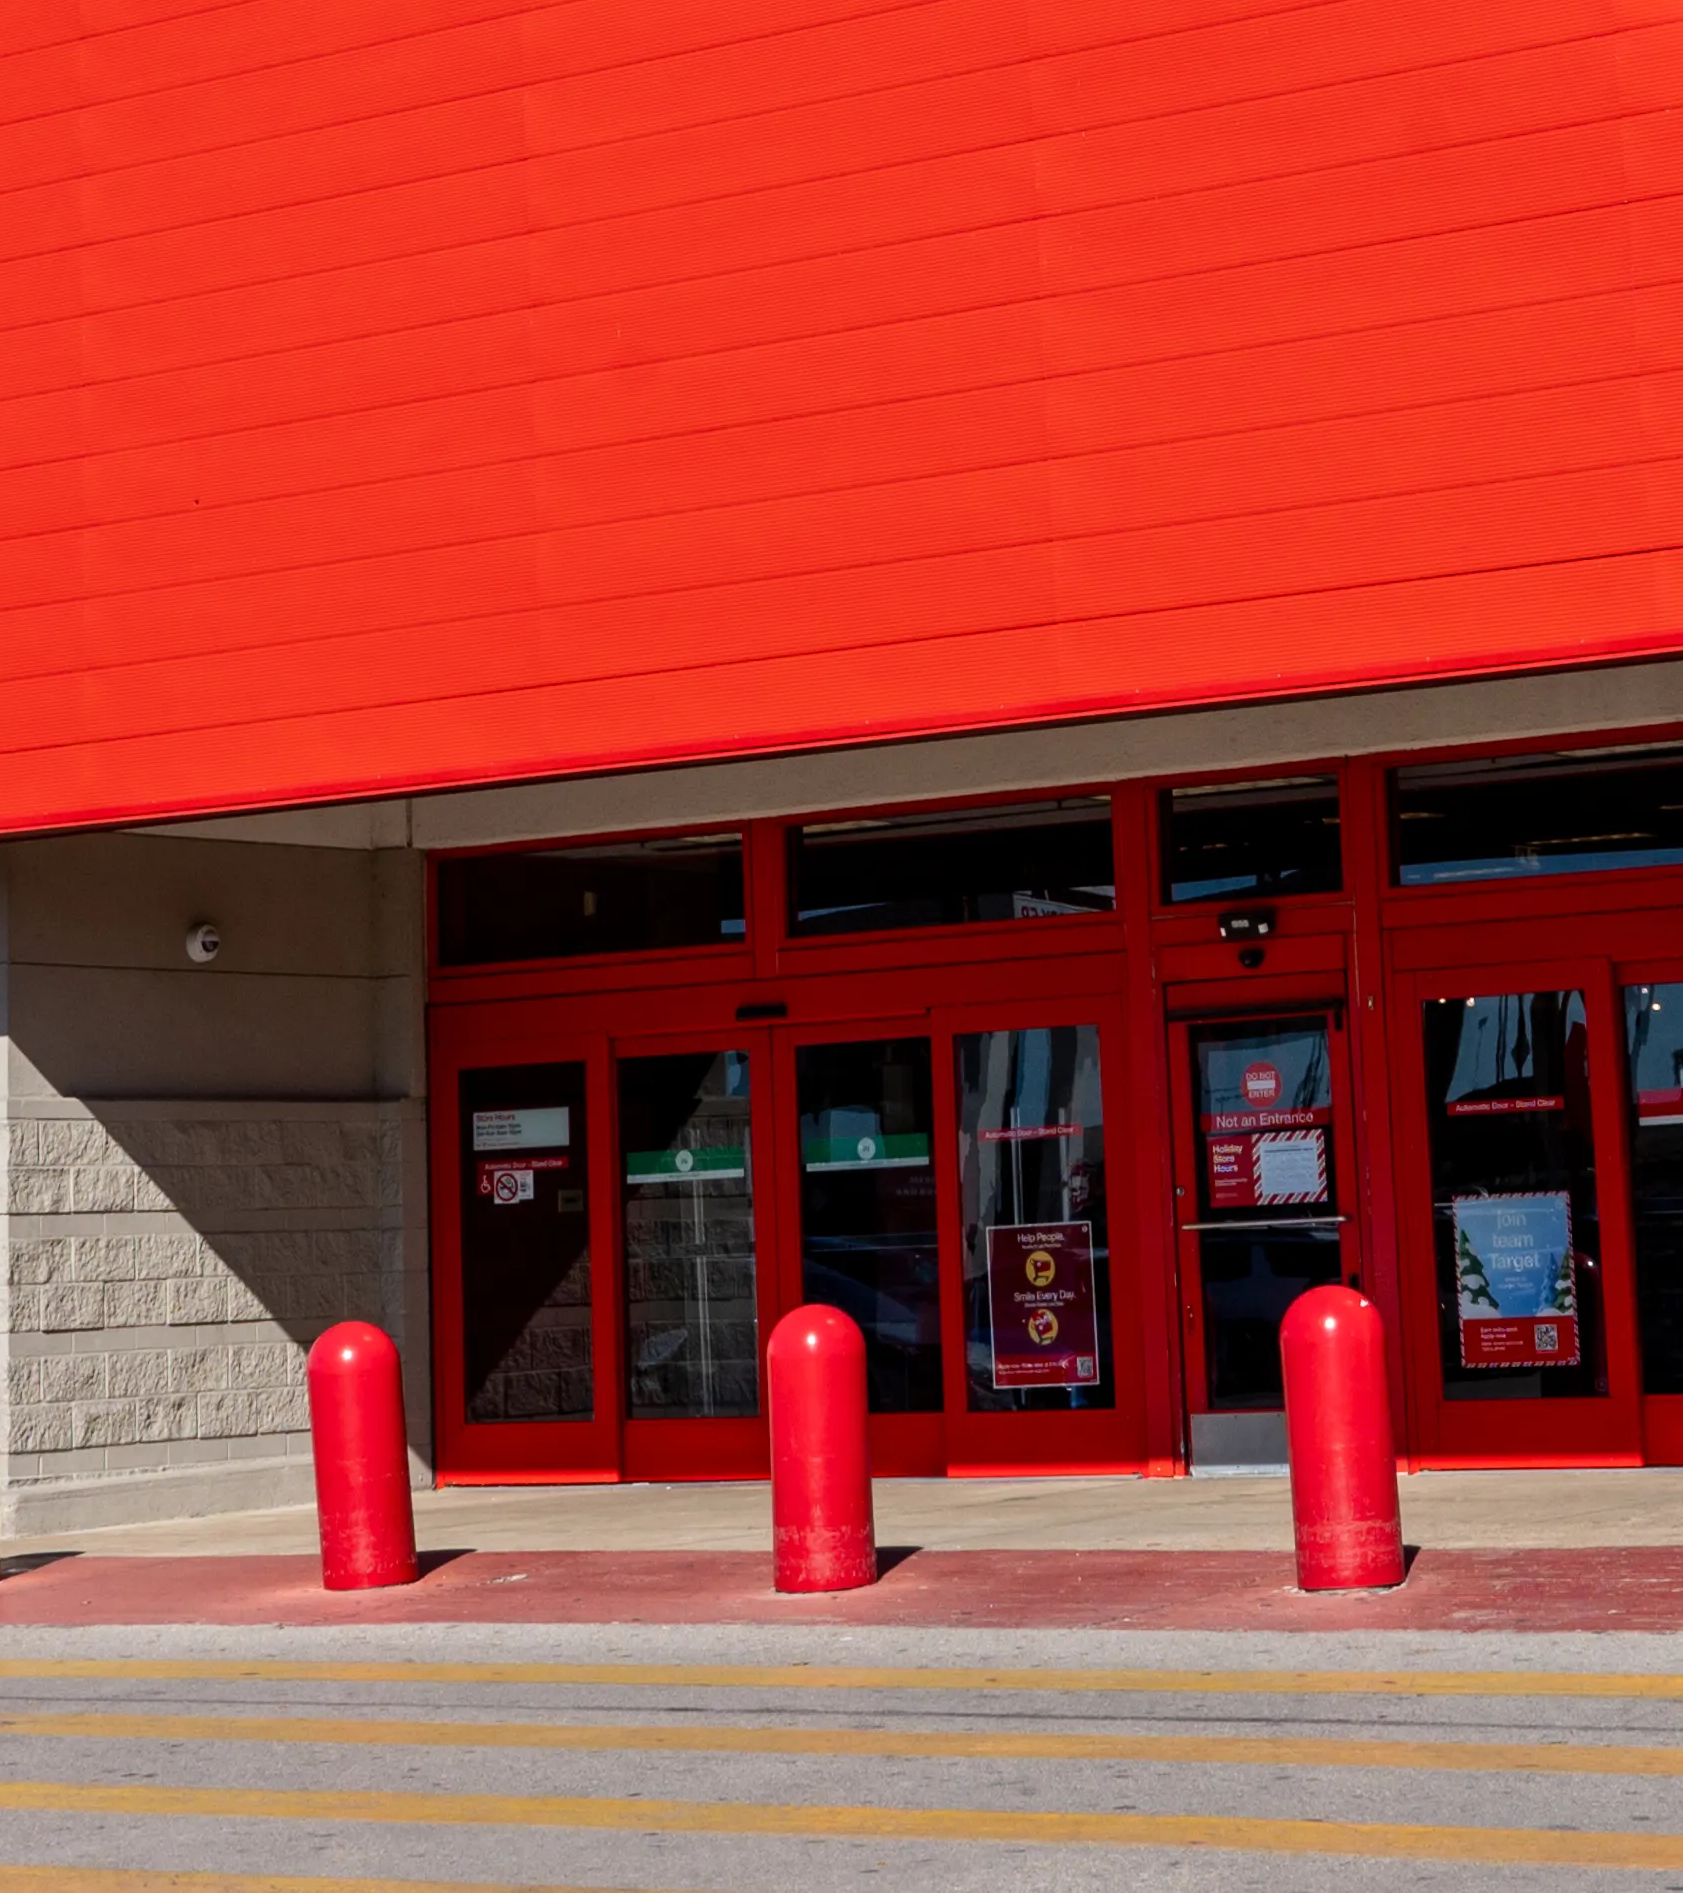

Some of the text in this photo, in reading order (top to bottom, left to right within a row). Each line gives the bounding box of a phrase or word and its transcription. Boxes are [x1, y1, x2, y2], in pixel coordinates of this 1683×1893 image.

[1246, 1071, 1275, 1081] DO NOT
[1248, 1089, 1275, 1098] ENTER
[1216, 1112, 1314, 1128] Not an Entrance
[1496, 1210, 1527, 1229] join
[1492, 1233, 1534, 1248] team
[1490, 1252, 1540, 1272] Target
